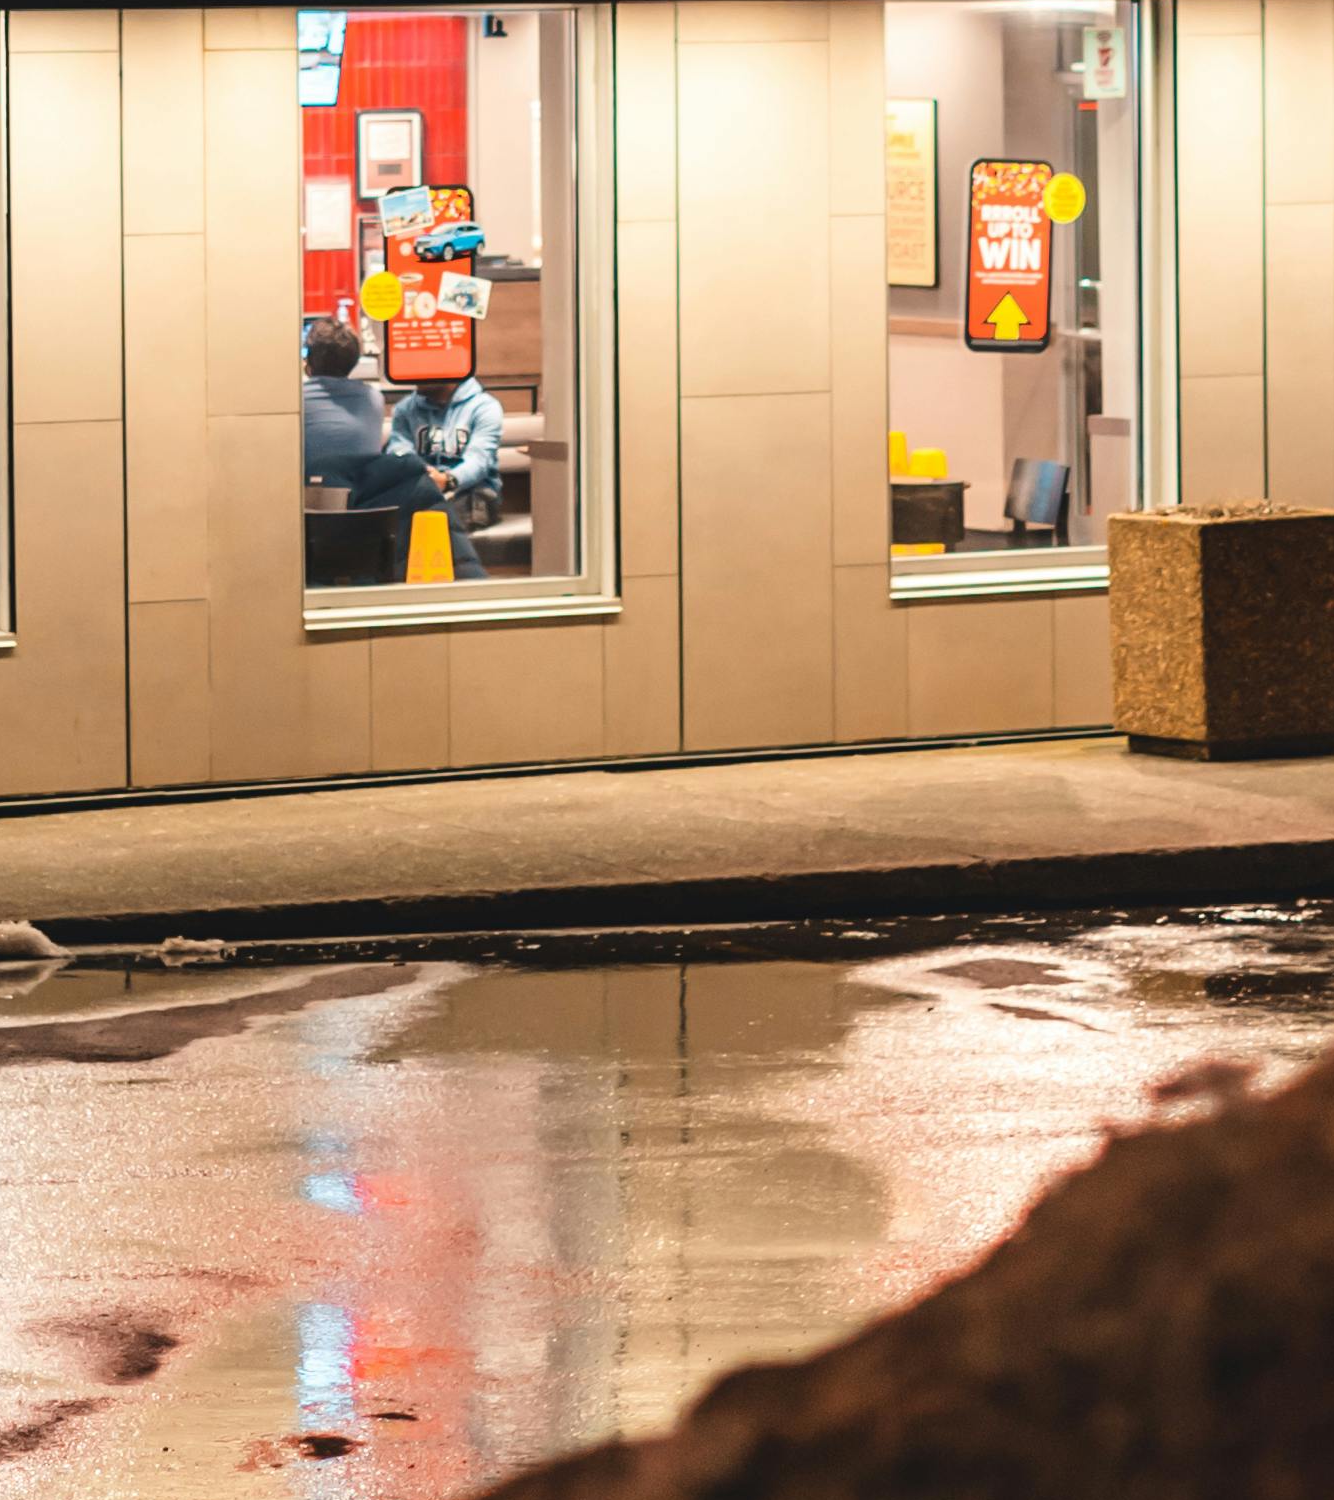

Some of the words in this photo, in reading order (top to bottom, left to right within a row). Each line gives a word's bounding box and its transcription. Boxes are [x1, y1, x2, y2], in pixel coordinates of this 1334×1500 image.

[987, 221, 1011, 239] UP
[1011, 222, 1034, 240] TO
[977, 236, 1042, 271] WIN
